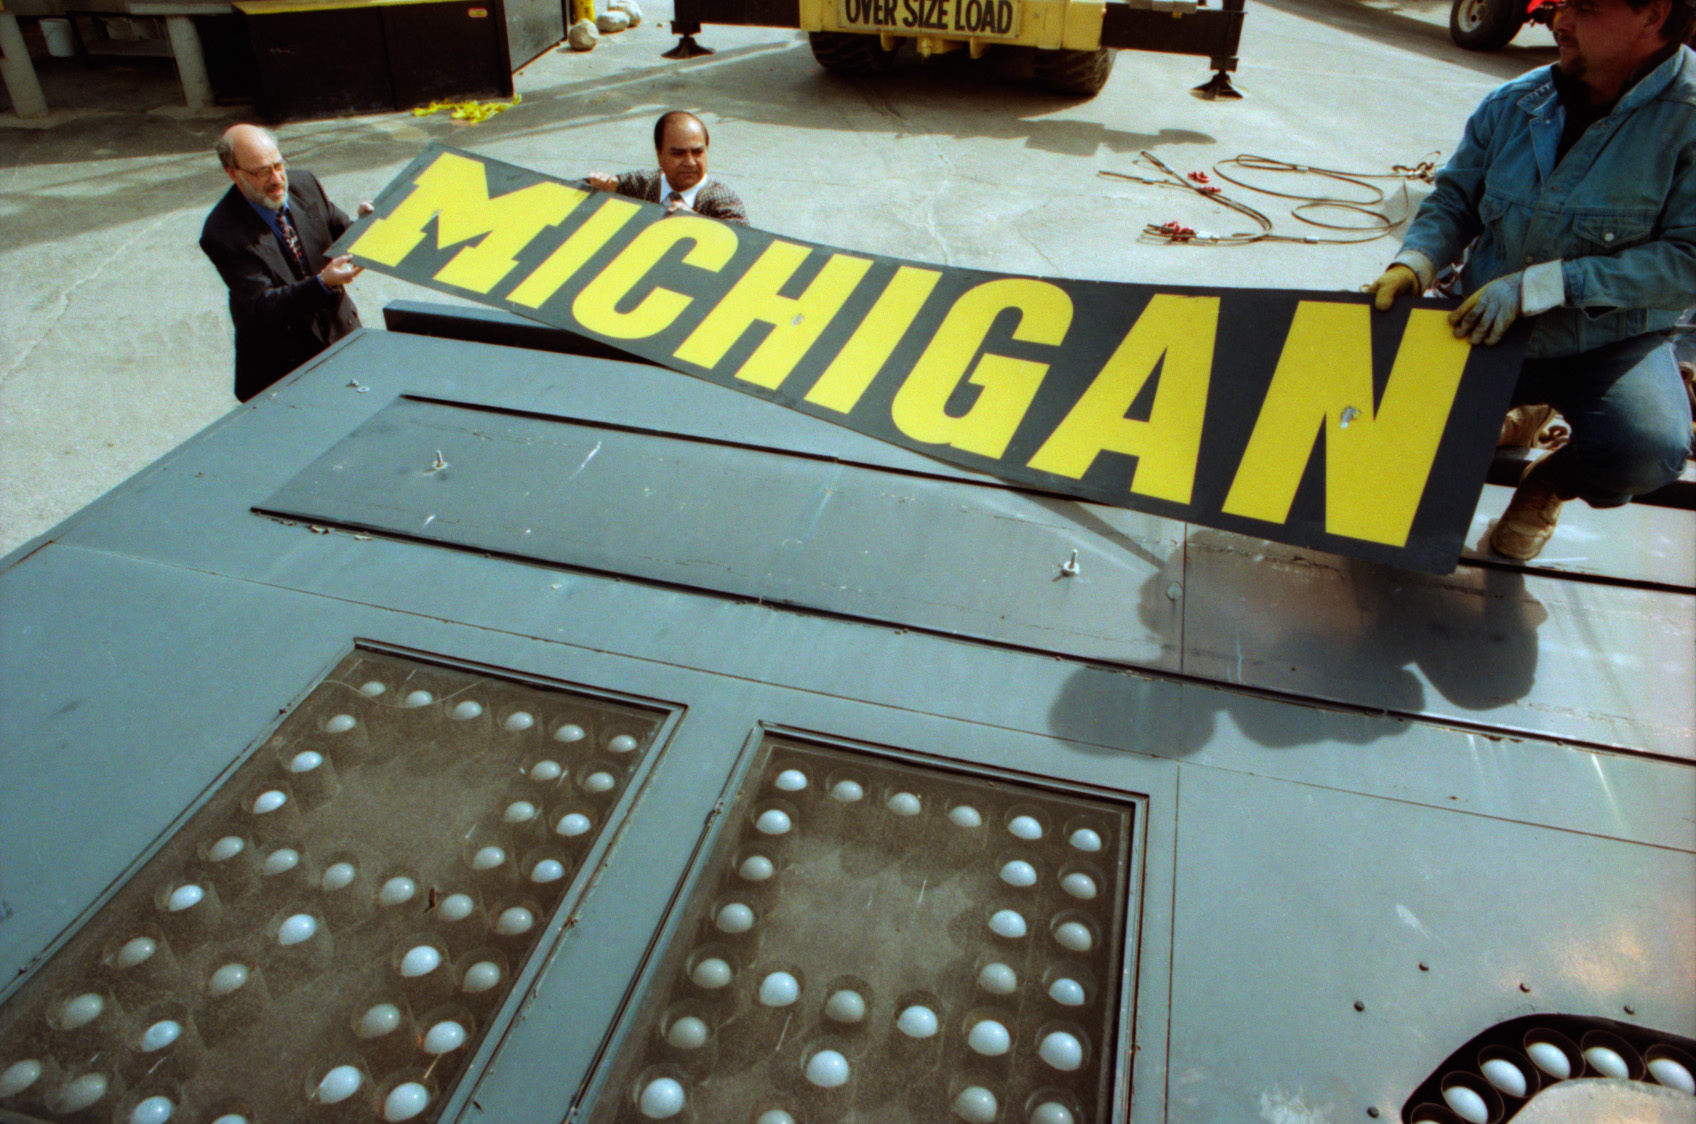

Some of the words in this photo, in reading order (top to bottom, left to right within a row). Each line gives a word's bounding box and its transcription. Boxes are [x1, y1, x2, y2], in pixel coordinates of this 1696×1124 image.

[845, 0, 897, 26] OVER
[903, 0, 948, 30] SIZE
[954, 0, 1013, 34] LOAD
[346, 152, 1471, 547] MICHIGAN
